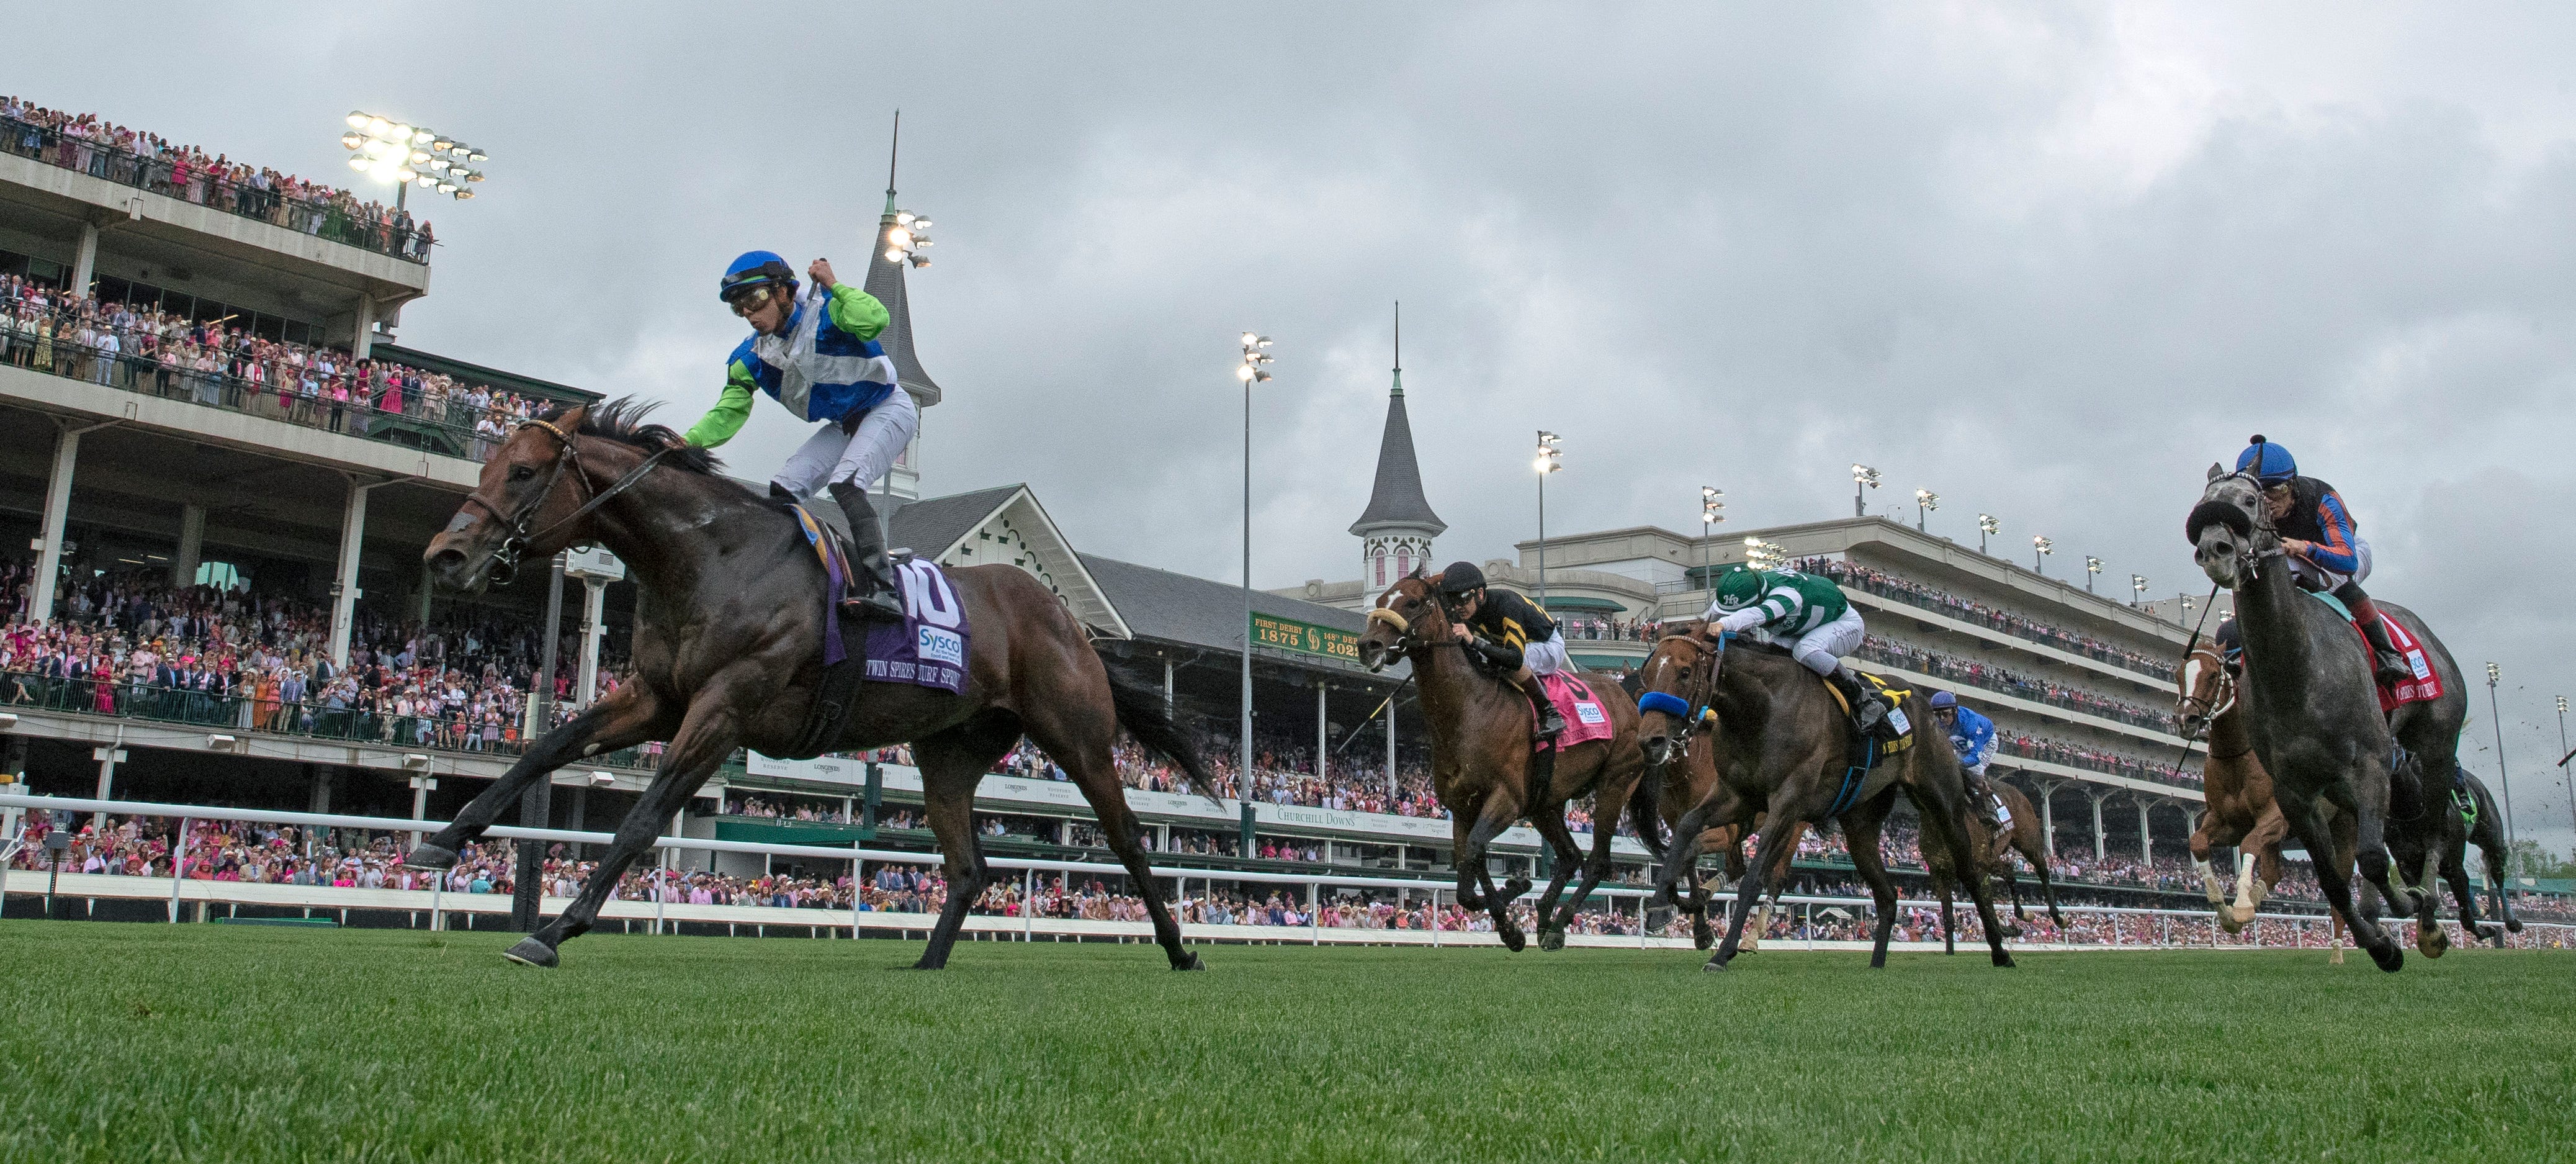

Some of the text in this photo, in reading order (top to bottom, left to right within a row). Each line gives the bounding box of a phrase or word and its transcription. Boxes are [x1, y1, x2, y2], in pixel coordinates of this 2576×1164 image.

[897, 557, 961, 628] 10
[1255, 618, 1303, 634] FIRST DERBY
[920, 628, 960, 654] Sysco
[1260, 629, 1298, 646] 1875
[1342, 635, 1358, 645] DER
[2410, 656, 2425, 669] sco
[866, 660, 888, 676] TWIN
[890, 661, 915, 679] SPIRES
[918, 664, 938, 682] TURF
[1577, 705, 1599, 718] Sysco
[814, 764, 840, 772] LONGINES
[1277, 808, 1355, 827] CHURCHILL DOWNS
